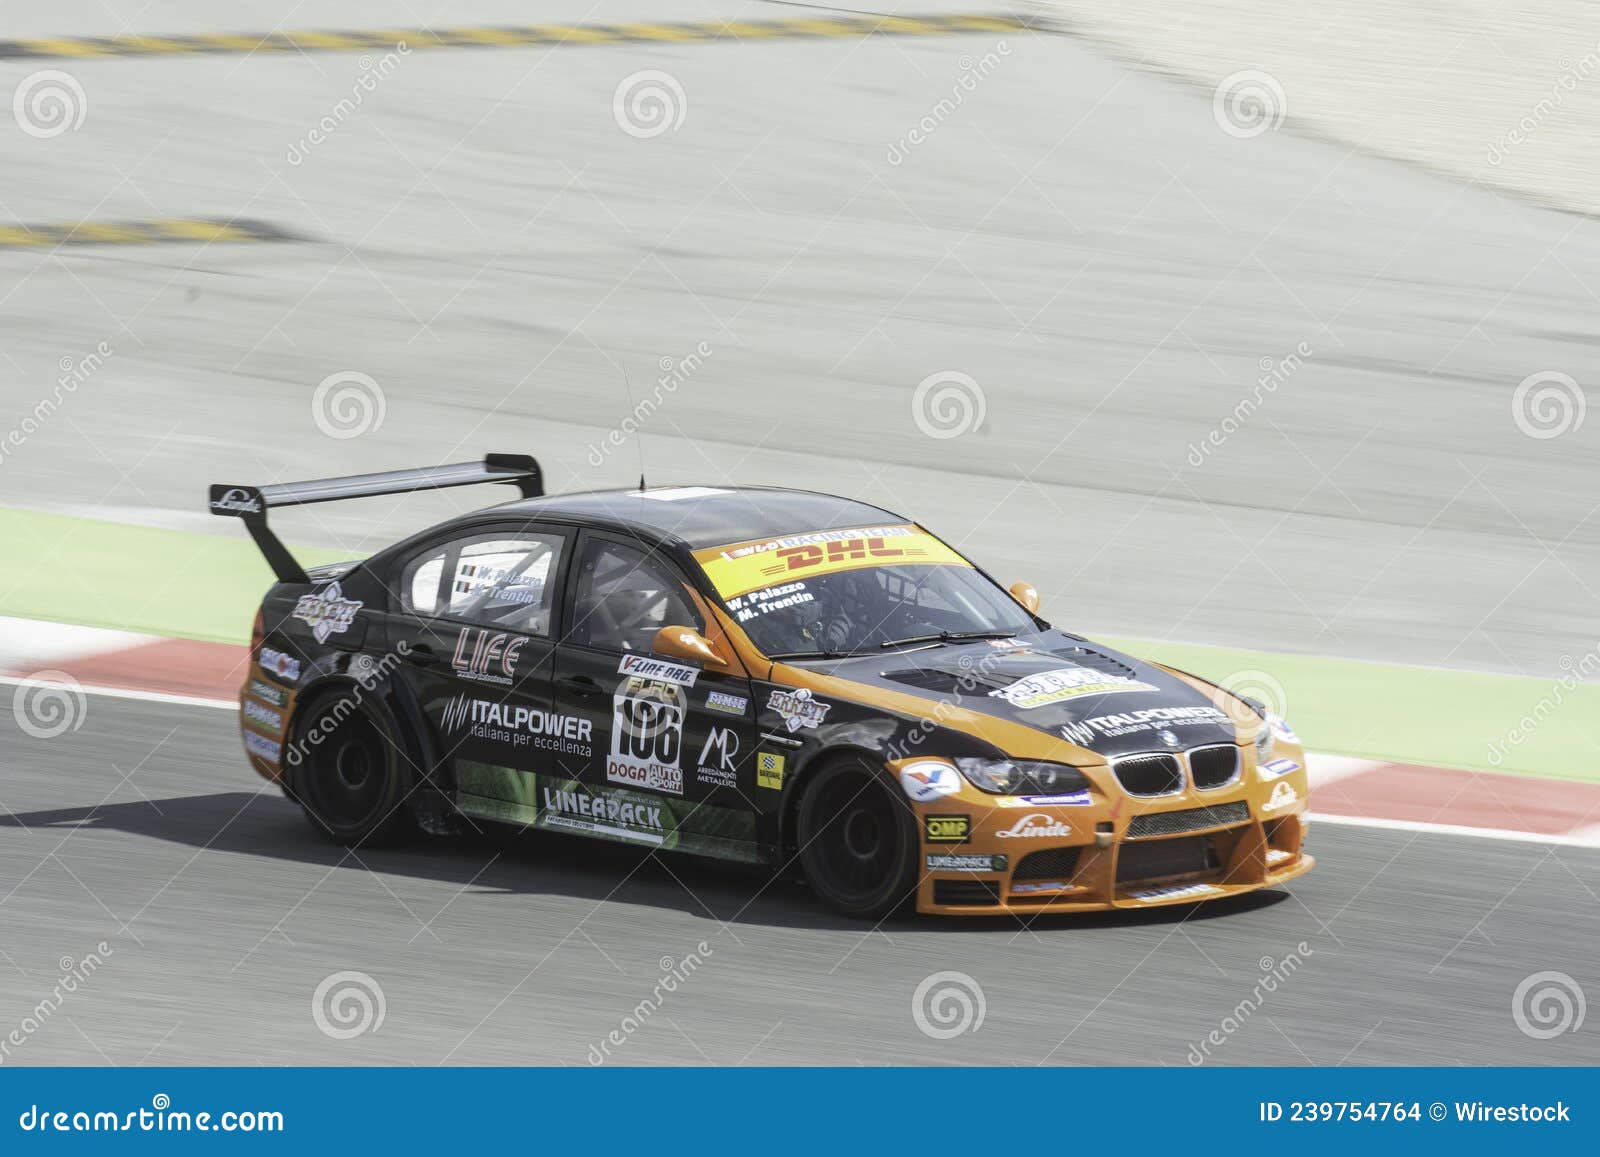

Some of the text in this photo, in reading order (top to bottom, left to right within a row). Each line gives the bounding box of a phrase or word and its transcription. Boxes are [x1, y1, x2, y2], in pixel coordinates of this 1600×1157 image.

[783, 531, 857, 549] RACING
[863, 527, 911, 540] TEAM
[776, 538, 904, 571] DHL
[489, 585, 534, 604] Trentin
[725, 581, 806, 612] W. Palazzo
[737, 591, 815, 623] M. Trentin
[452, 626, 530, 678] LIFE
[471, 699, 592, 742] ITALPOWER
[1084, 706, 1226, 730] ITALPOWER
[471, 722, 592, 757] italiana per eccellenza
[617, 698, 681, 764] 106
[608, 761, 647, 782] DOGA
[650, 764, 682, 783] AUTO
[649, 777, 682, 792] SPORT
[928, 822, 967, 836] OMP
[994, 813, 1072, 838] Linde
